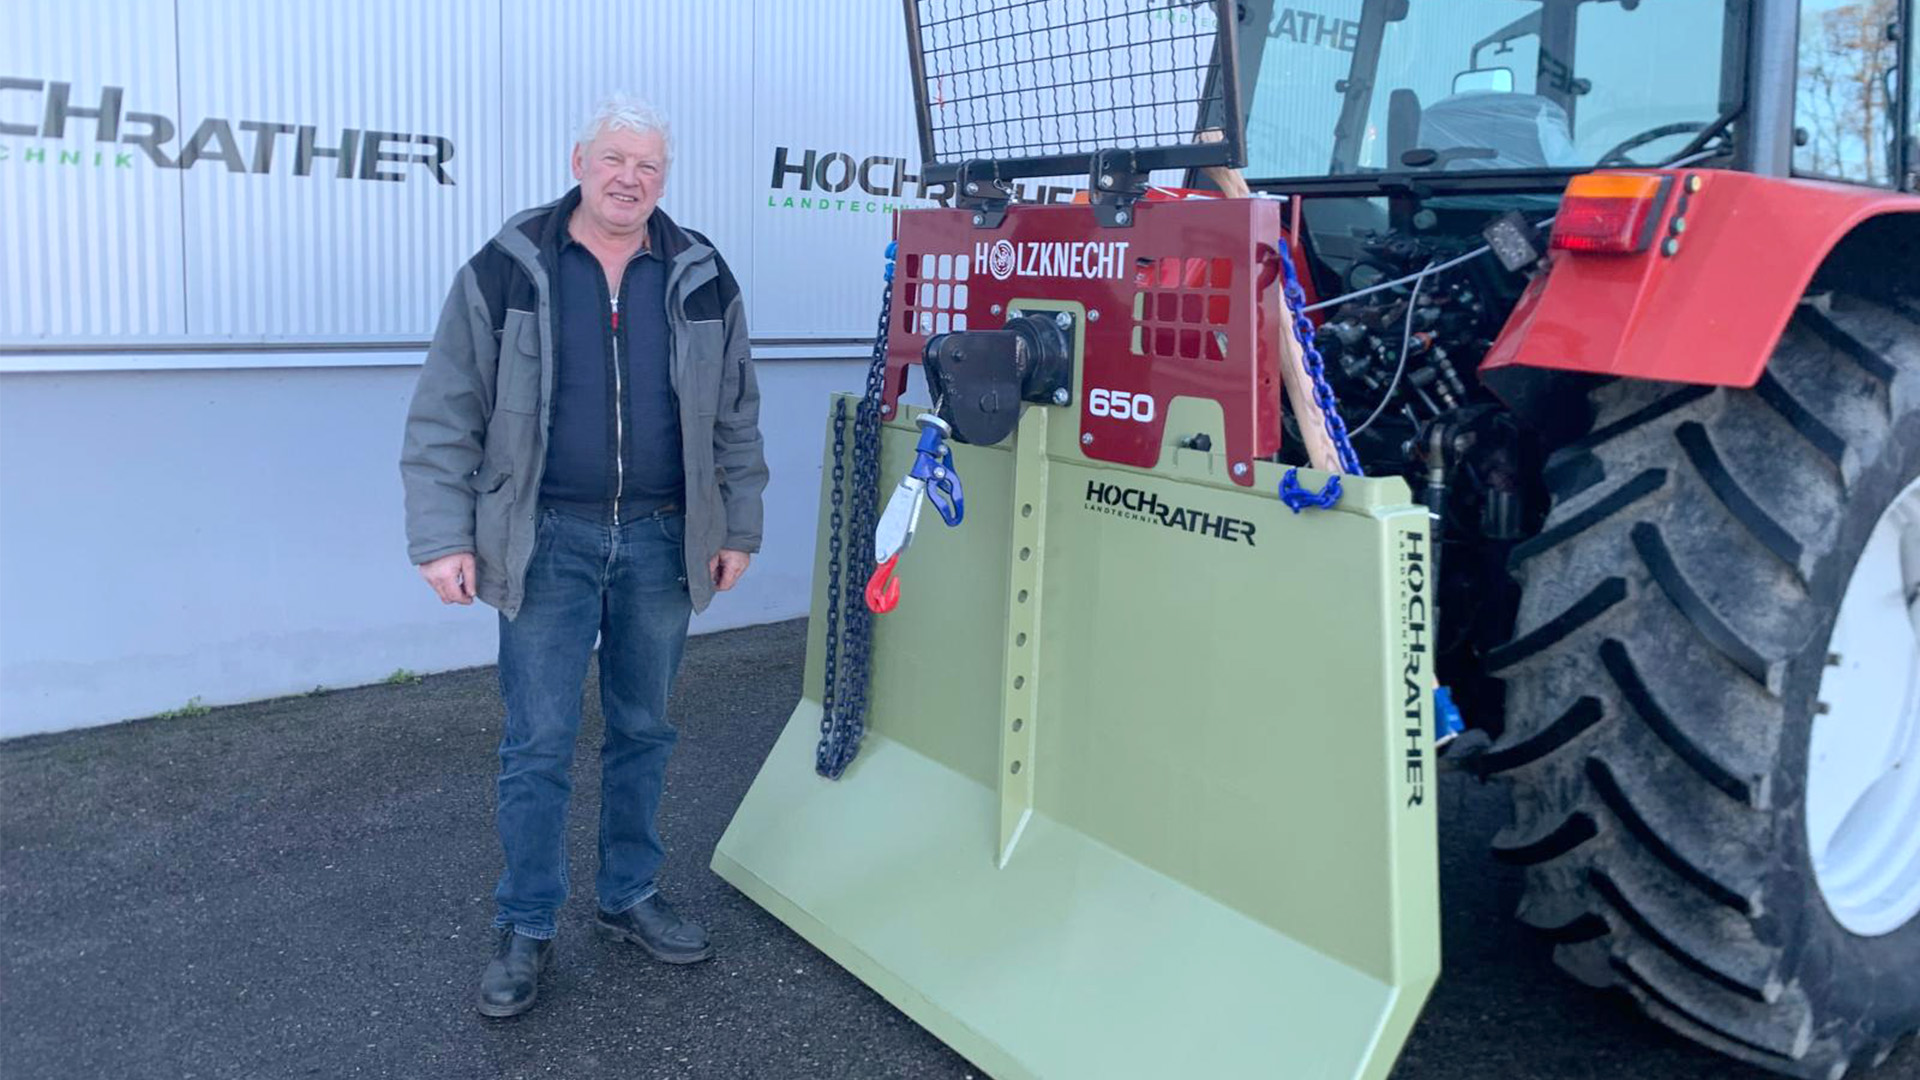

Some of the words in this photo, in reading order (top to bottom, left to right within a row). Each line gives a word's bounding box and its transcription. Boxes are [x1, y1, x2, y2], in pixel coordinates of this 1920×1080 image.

[974, 239, 1129, 280] HOLZKNECHT
[1089, 388, 1155, 422] 650
[1084, 503, 1159, 525] LANDTECHNIK
[1085, 480, 1257, 547] HOCHRATHER
[1403, 531, 1426, 808] HOCHRATHER
